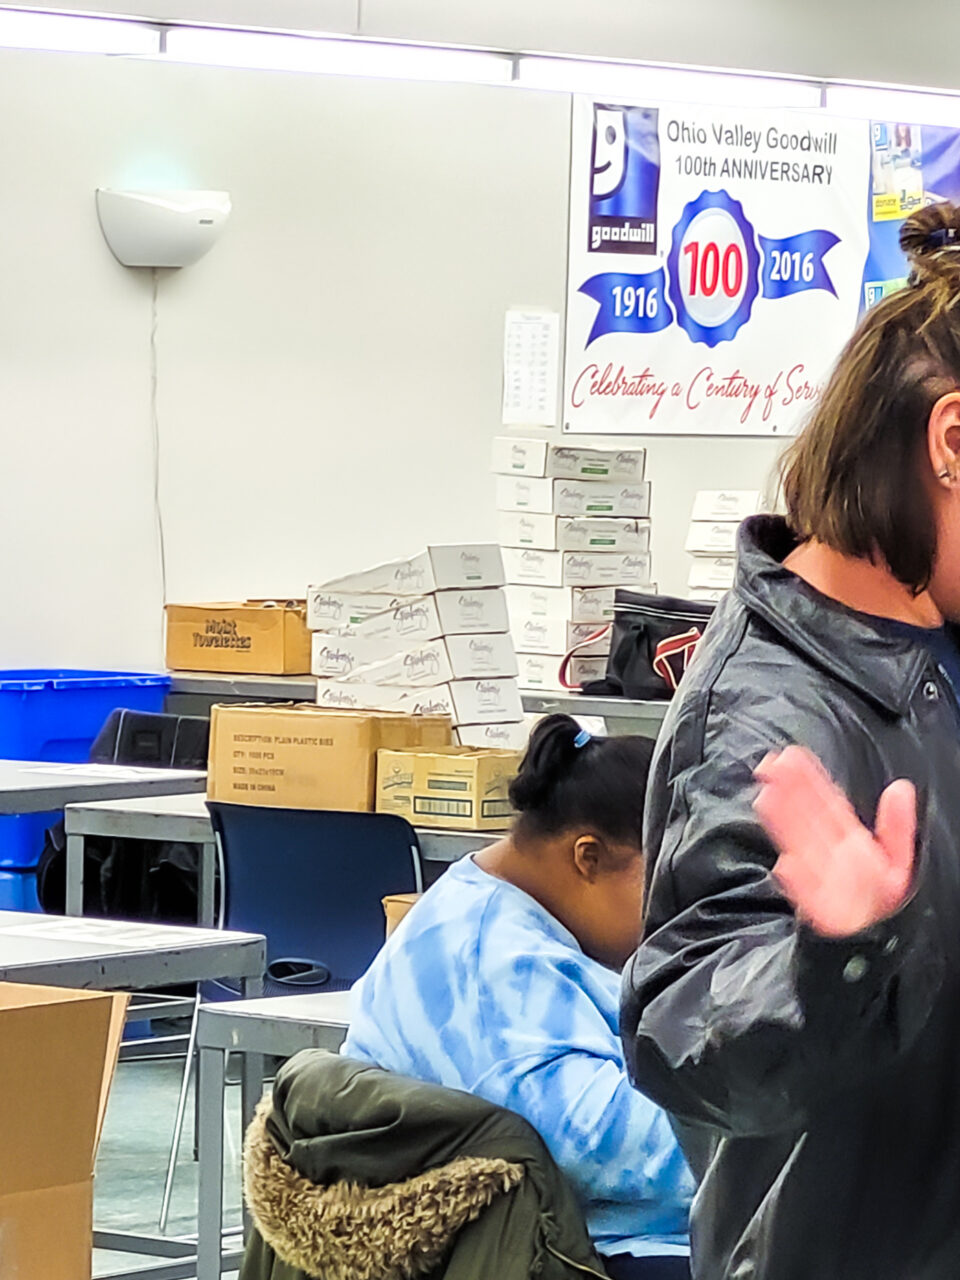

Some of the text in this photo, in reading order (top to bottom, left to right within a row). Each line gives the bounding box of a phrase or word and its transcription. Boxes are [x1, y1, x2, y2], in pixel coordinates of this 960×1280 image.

[667, 119, 837, 155] Ohio Valley Goodwill
[675, 155, 833, 186] 100th ANNIVERSARY
[591, 222, 655, 249] goodwill
[683, 241, 743, 298] 100
[769, 250, 814, 282] 2016
[611, 286, 658, 318] 1916
[571, 362, 667, 420] Celebrating
[671, 383, 683, 397] a
[686, 366, 760, 424] Century
[764, 371, 783, 421] of
